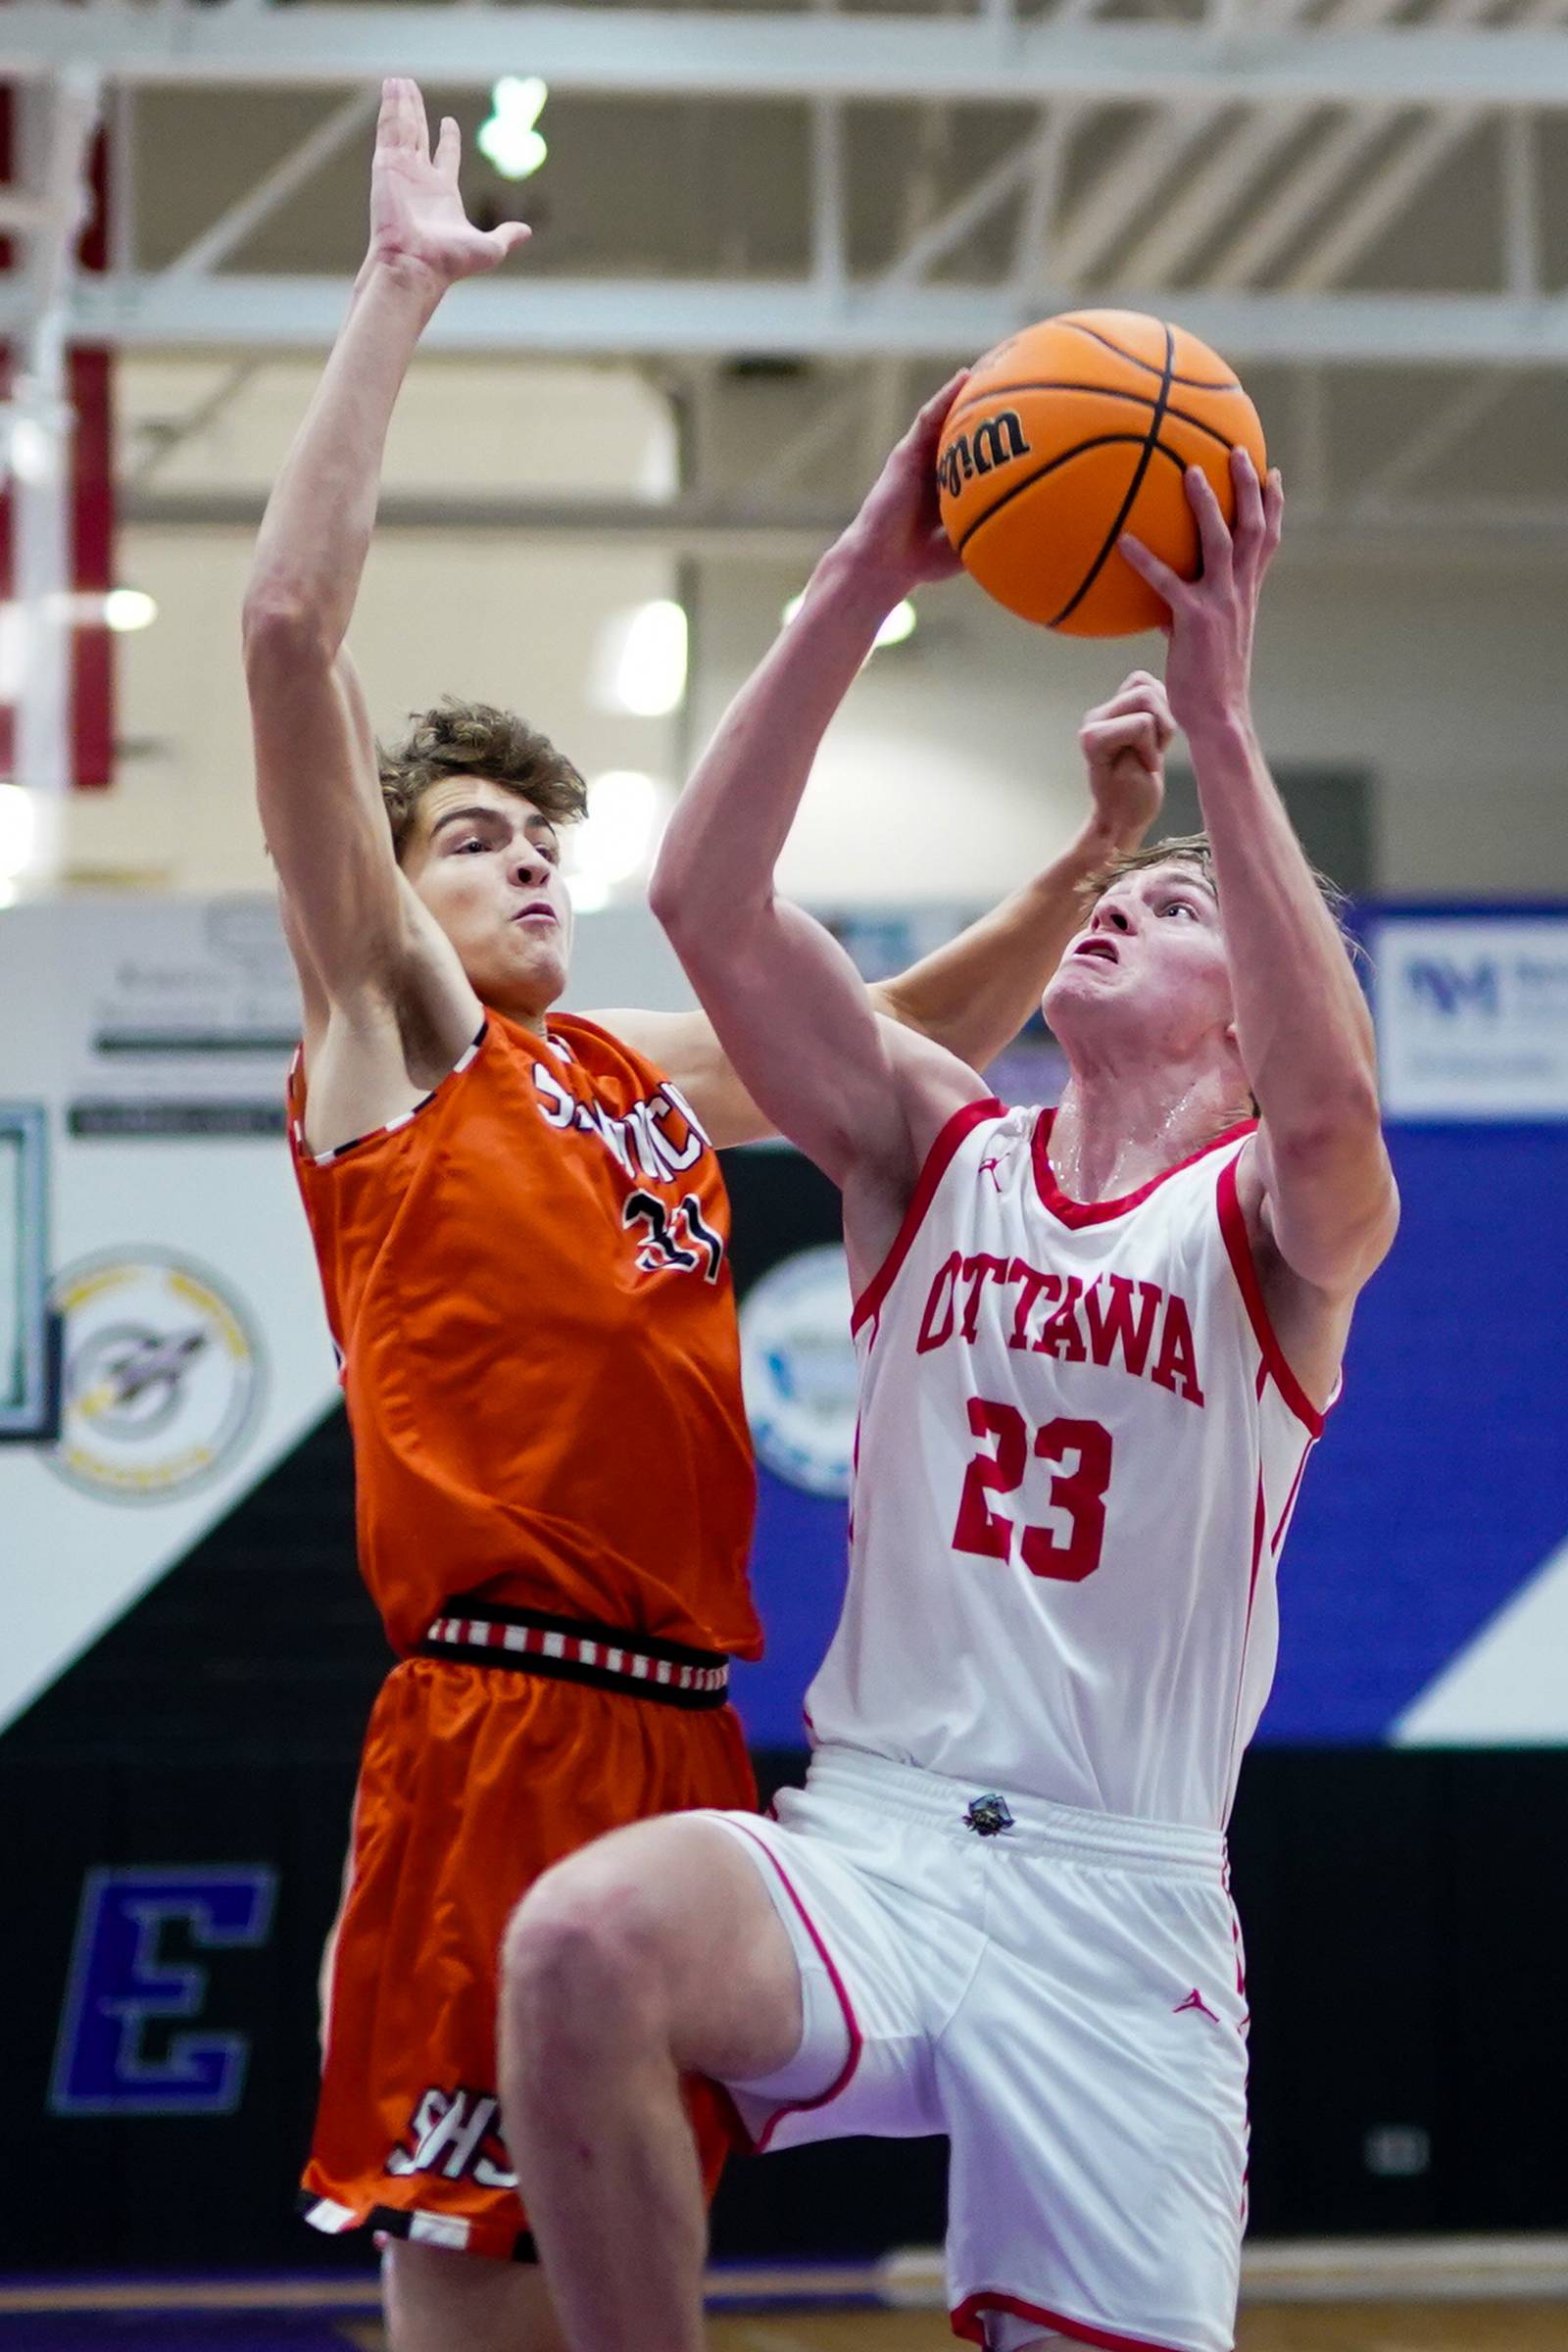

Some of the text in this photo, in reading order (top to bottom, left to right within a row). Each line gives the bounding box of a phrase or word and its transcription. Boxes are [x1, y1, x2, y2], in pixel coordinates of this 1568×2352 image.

[622, 1188, 723, 1286] 31
[916, 1250, 1205, 1408] OTTAWA
[952, 1396, 1113, 1583] 23
[50, 1864, 278, 2114] E
